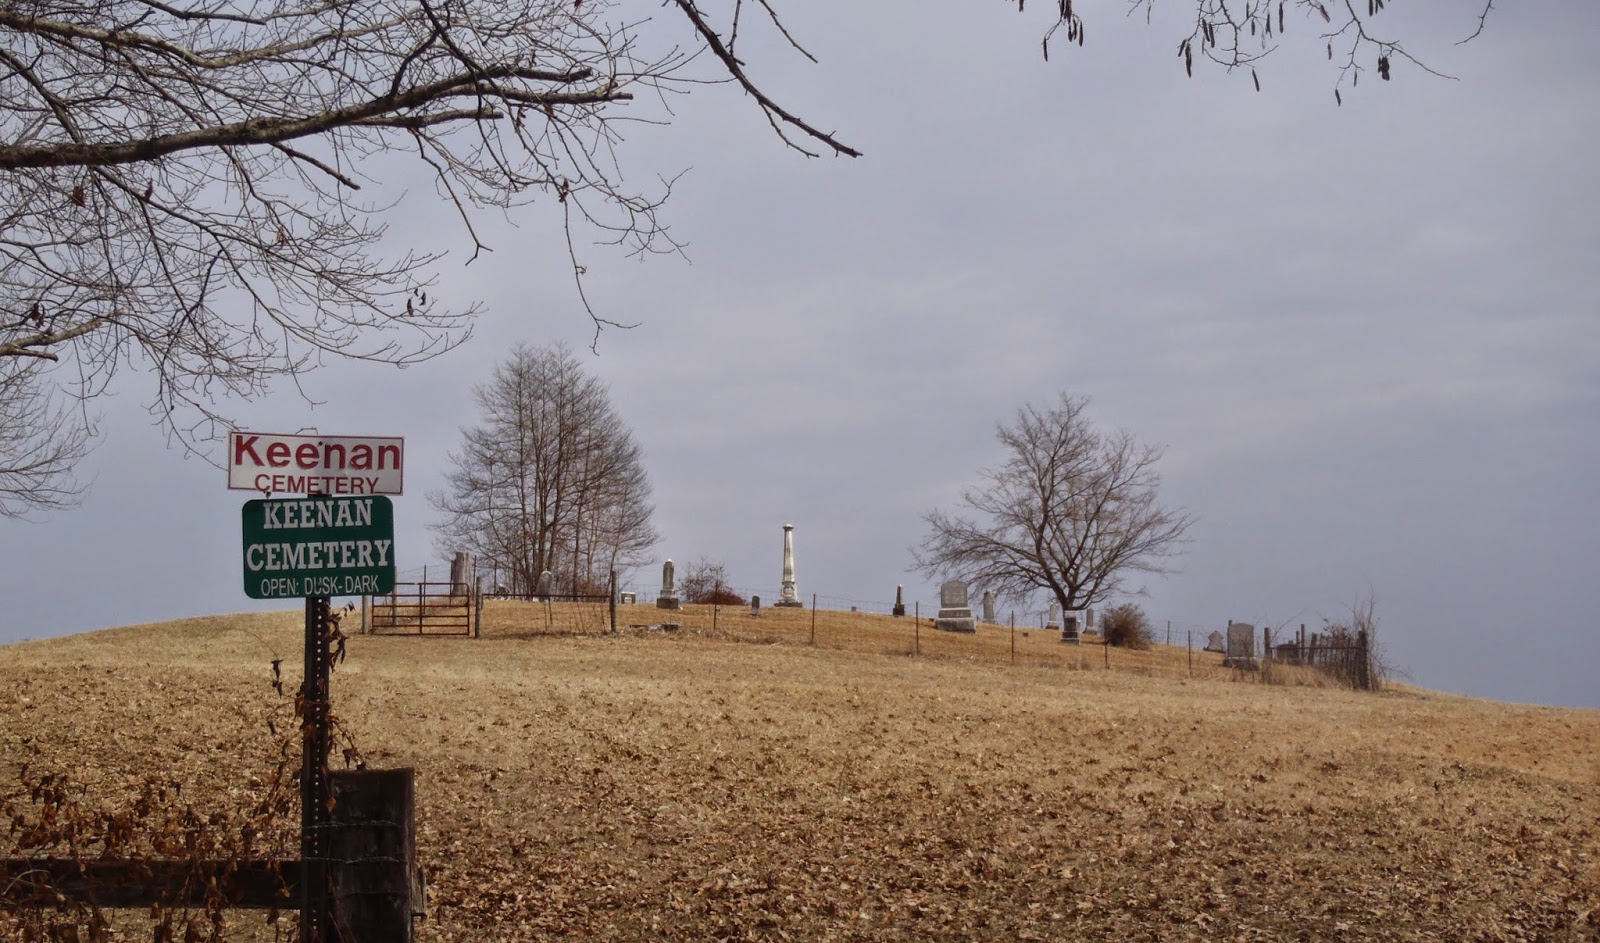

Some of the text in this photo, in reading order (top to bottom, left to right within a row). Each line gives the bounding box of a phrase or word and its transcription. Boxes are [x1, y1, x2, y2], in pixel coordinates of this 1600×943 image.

[234, 435, 400, 470] Keenan
[254, 474, 380, 494] CEMETERY
[263, 499, 373, 530] KEENAN
[246, 539, 392, 572] CEMETERY
[260, 578, 300, 597] OPEN:
